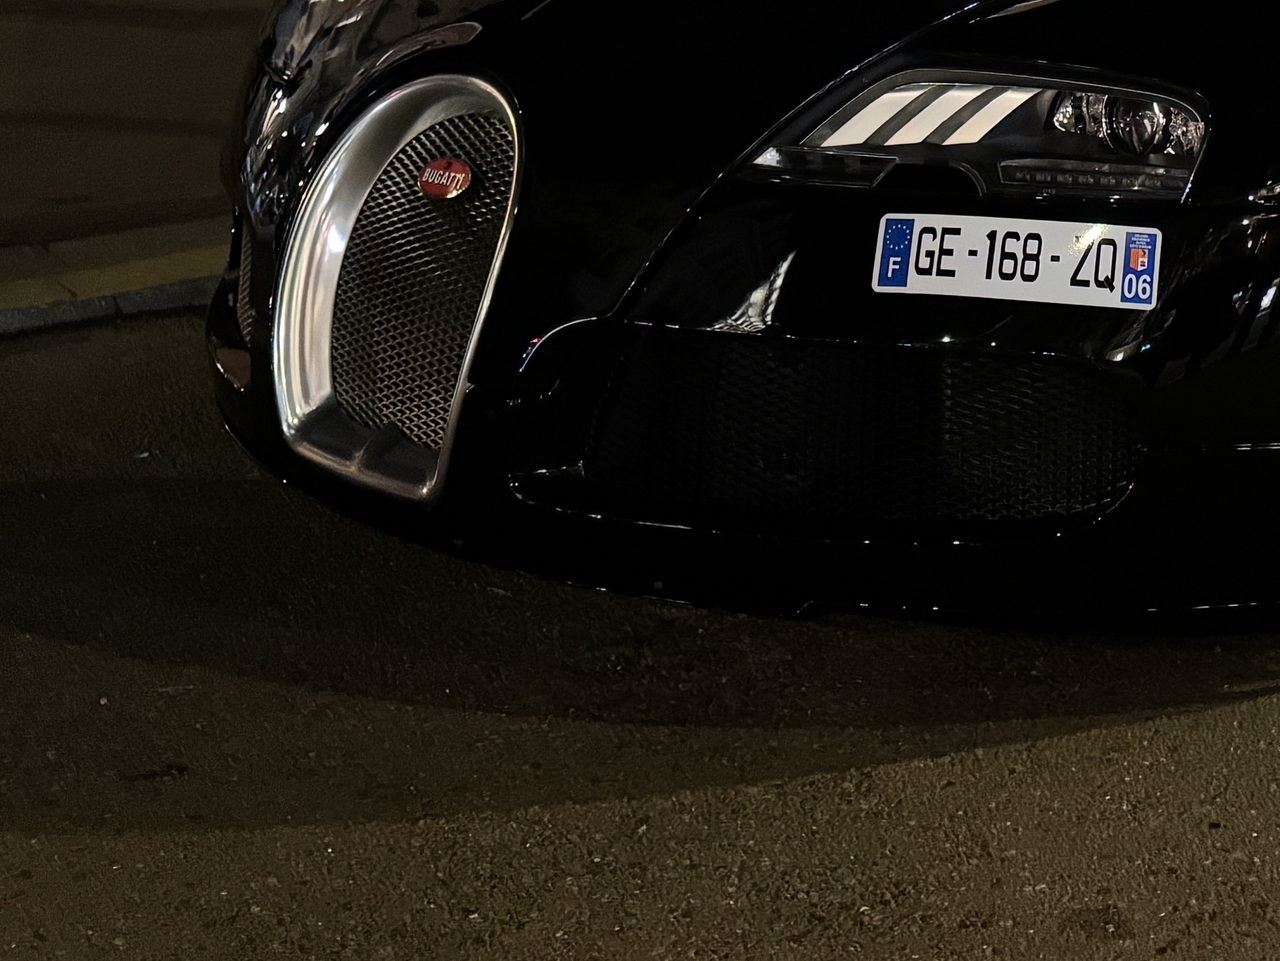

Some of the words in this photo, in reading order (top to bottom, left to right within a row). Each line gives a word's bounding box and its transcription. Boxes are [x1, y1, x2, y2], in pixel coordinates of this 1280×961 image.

[422, 168, 466, 190] BUGATTI
[887, 257, 901, 278] F
[1123, 273, 1152, 300] 06
